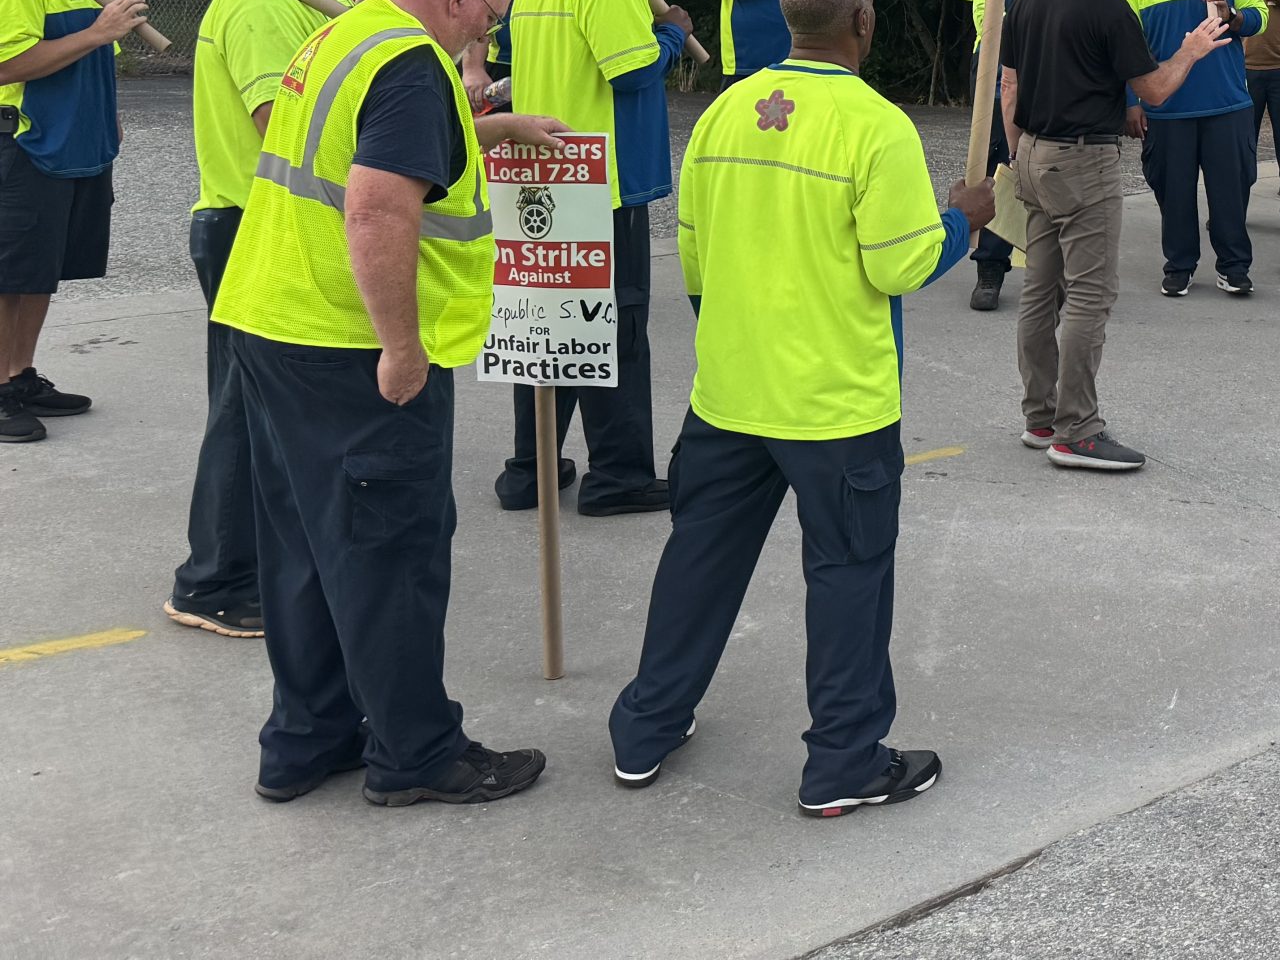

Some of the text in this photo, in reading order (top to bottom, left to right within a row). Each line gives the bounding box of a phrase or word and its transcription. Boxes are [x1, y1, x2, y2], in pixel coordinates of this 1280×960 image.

[490, 163, 590, 181] Local 728
[521, 243, 605, 267] Strike
[509, 268, 571, 285] Against
[530, 327, 550, 335] FOR
[484, 335, 611, 355] Unfair Labor
[484, 353, 611, 379] Practices
